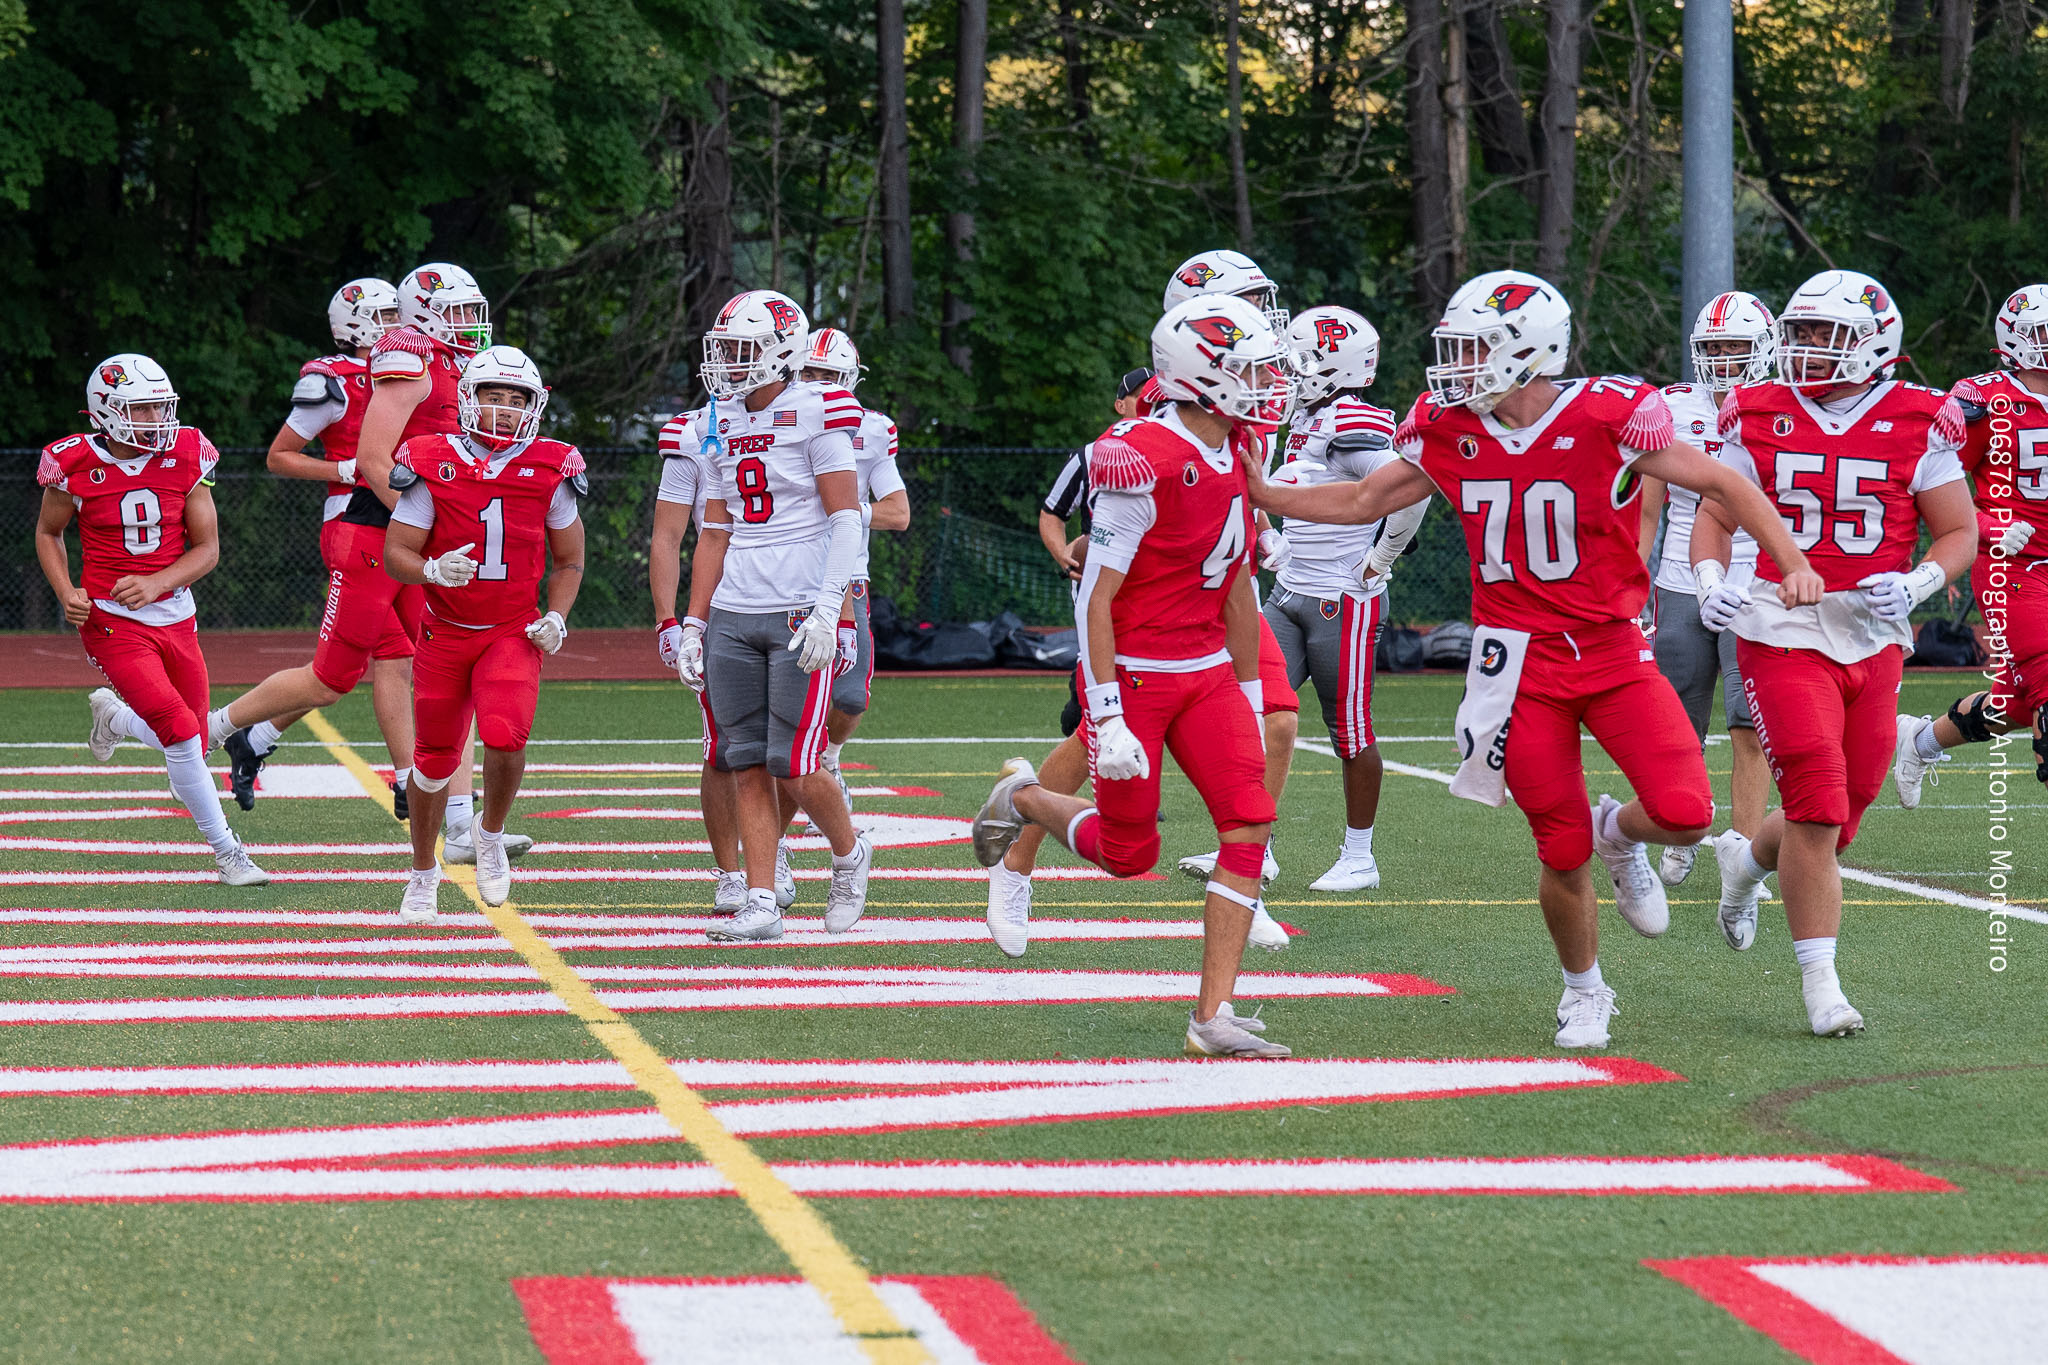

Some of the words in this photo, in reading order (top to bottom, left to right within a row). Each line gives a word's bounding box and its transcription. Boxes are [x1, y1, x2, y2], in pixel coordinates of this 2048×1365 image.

[763, 299, 798, 336] FP
[1313, 317, 1349, 353] FP
[51, 436, 82, 454] 8
[728, 433, 775, 457] PREP
[1110, 417, 1145, 438] 4
[119, 487, 163, 556] 8
[735, 456, 774, 524] 8
[1773, 450, 1889, 556] 55
[477, 497, 509, 581] 1
[1200, 493, 1246, 590] 4
[1460, 478, 1581, 585] 70
[319, 569, 343, 642] CARDINALS
[1744, 678, 1784, 782] CARDINALS
